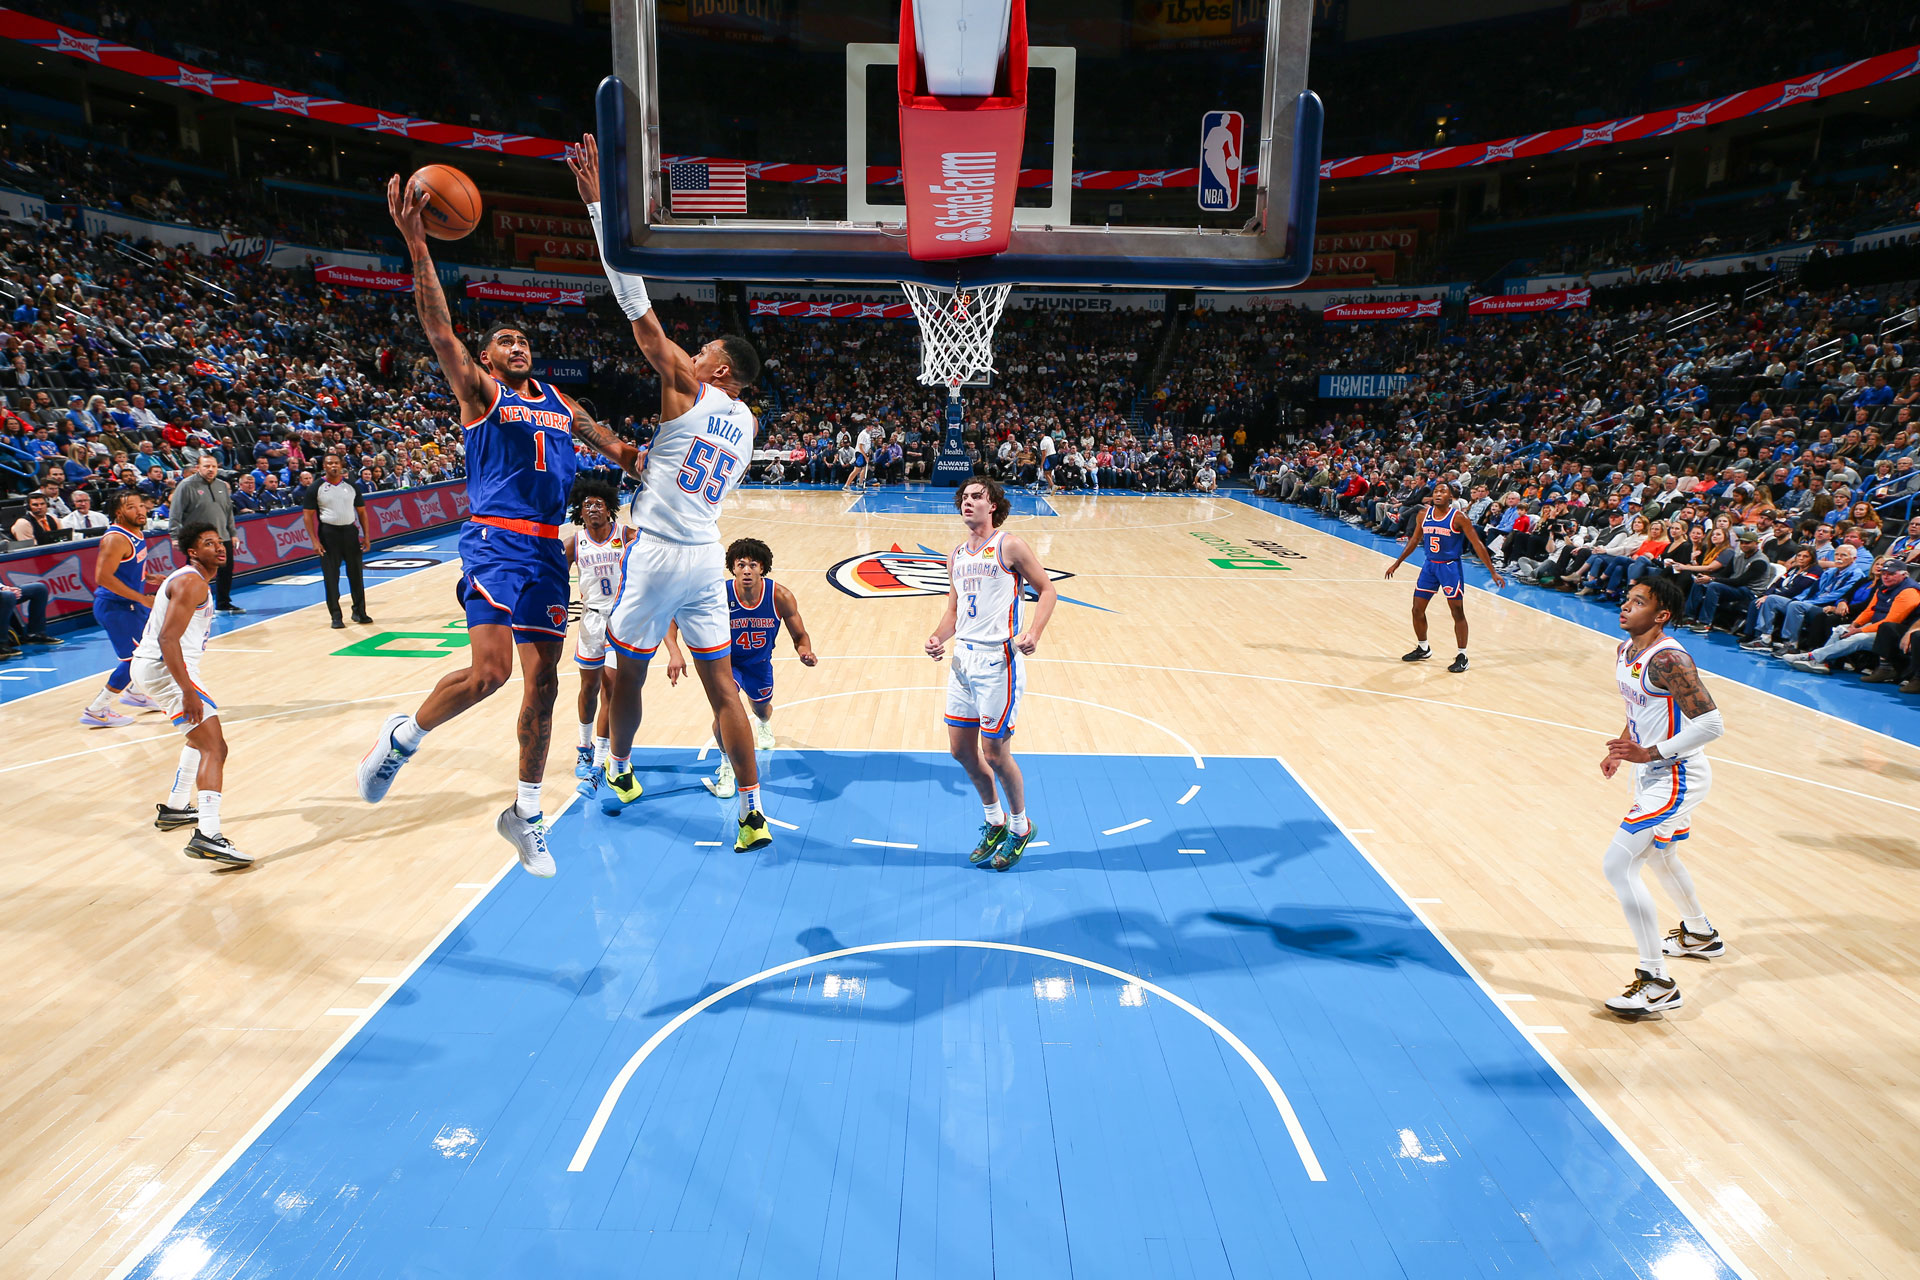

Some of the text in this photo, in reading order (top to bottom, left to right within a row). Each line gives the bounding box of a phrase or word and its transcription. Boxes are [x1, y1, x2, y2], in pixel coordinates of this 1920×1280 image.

[62, 37, 98, 54] SONIC
[183, 73, 209, 88] SONIC
[1787, 83, 1817, 97] SONIC
[277, 98, 304, 109] SONIC
[1679, 111, 1705, 124] SONIC
[380, 119, 404, 130] SONIC
[476, 136, 500, 146] SONIC
[1585, 130, 1610, 140] SONIC
[1488, 147, 1512, 156] SONIC
[1393, 159, 1418, 168] SONIC
[1204, 188, 1224, 205] NBA
[328, 270, 343, 280] This
[343, 273, 349, 281] is
[351, 274, 365, 282] how
[376, 277, 402, 286] SONIC
[479, 287, 493, 295] This
[501, 289, 514, 297] how
[526, 291, 551, 299] SONIC
[697, 288, 714, 299] 119
[1023, 297, 1112, 309] THUNDER
[1148, 299, 1164, 309] 101
[1535, 297, 1557, 305] SONIC
[1336, 308, 1350, 316] This
[1351, 308, 1358, 316] is
[1359, 307, 1374, 315] how
[1386, 306, 1408, 314] SONIC
[553, 368, 583, 377] ULTRA
[1330, 375, 1408, 398] HOMELAND
[499, 406, 570, 434] NEW YORK
[707, 415, 743, 446] BAZLEY
[534, 430, 547, 472] 1
[676, 436, 738, 505] 55
[380, 508, 404, 521] SONIC
[420, 502, 441, 515] SONIC
[276, 530, 309, 546] SONIC
[1430, 536, 1440, 553] 5
[580, 551, 621, 568] OKLAHOM
[594, 564, 614, 576] CITY
[600, 577, 612, 596] 8
[963, 577, 982, 591] CITY
[967, 592, 977, 619] 3
[749, 617, 775, 628] YORK
[736, 631, 766, 650] 45
